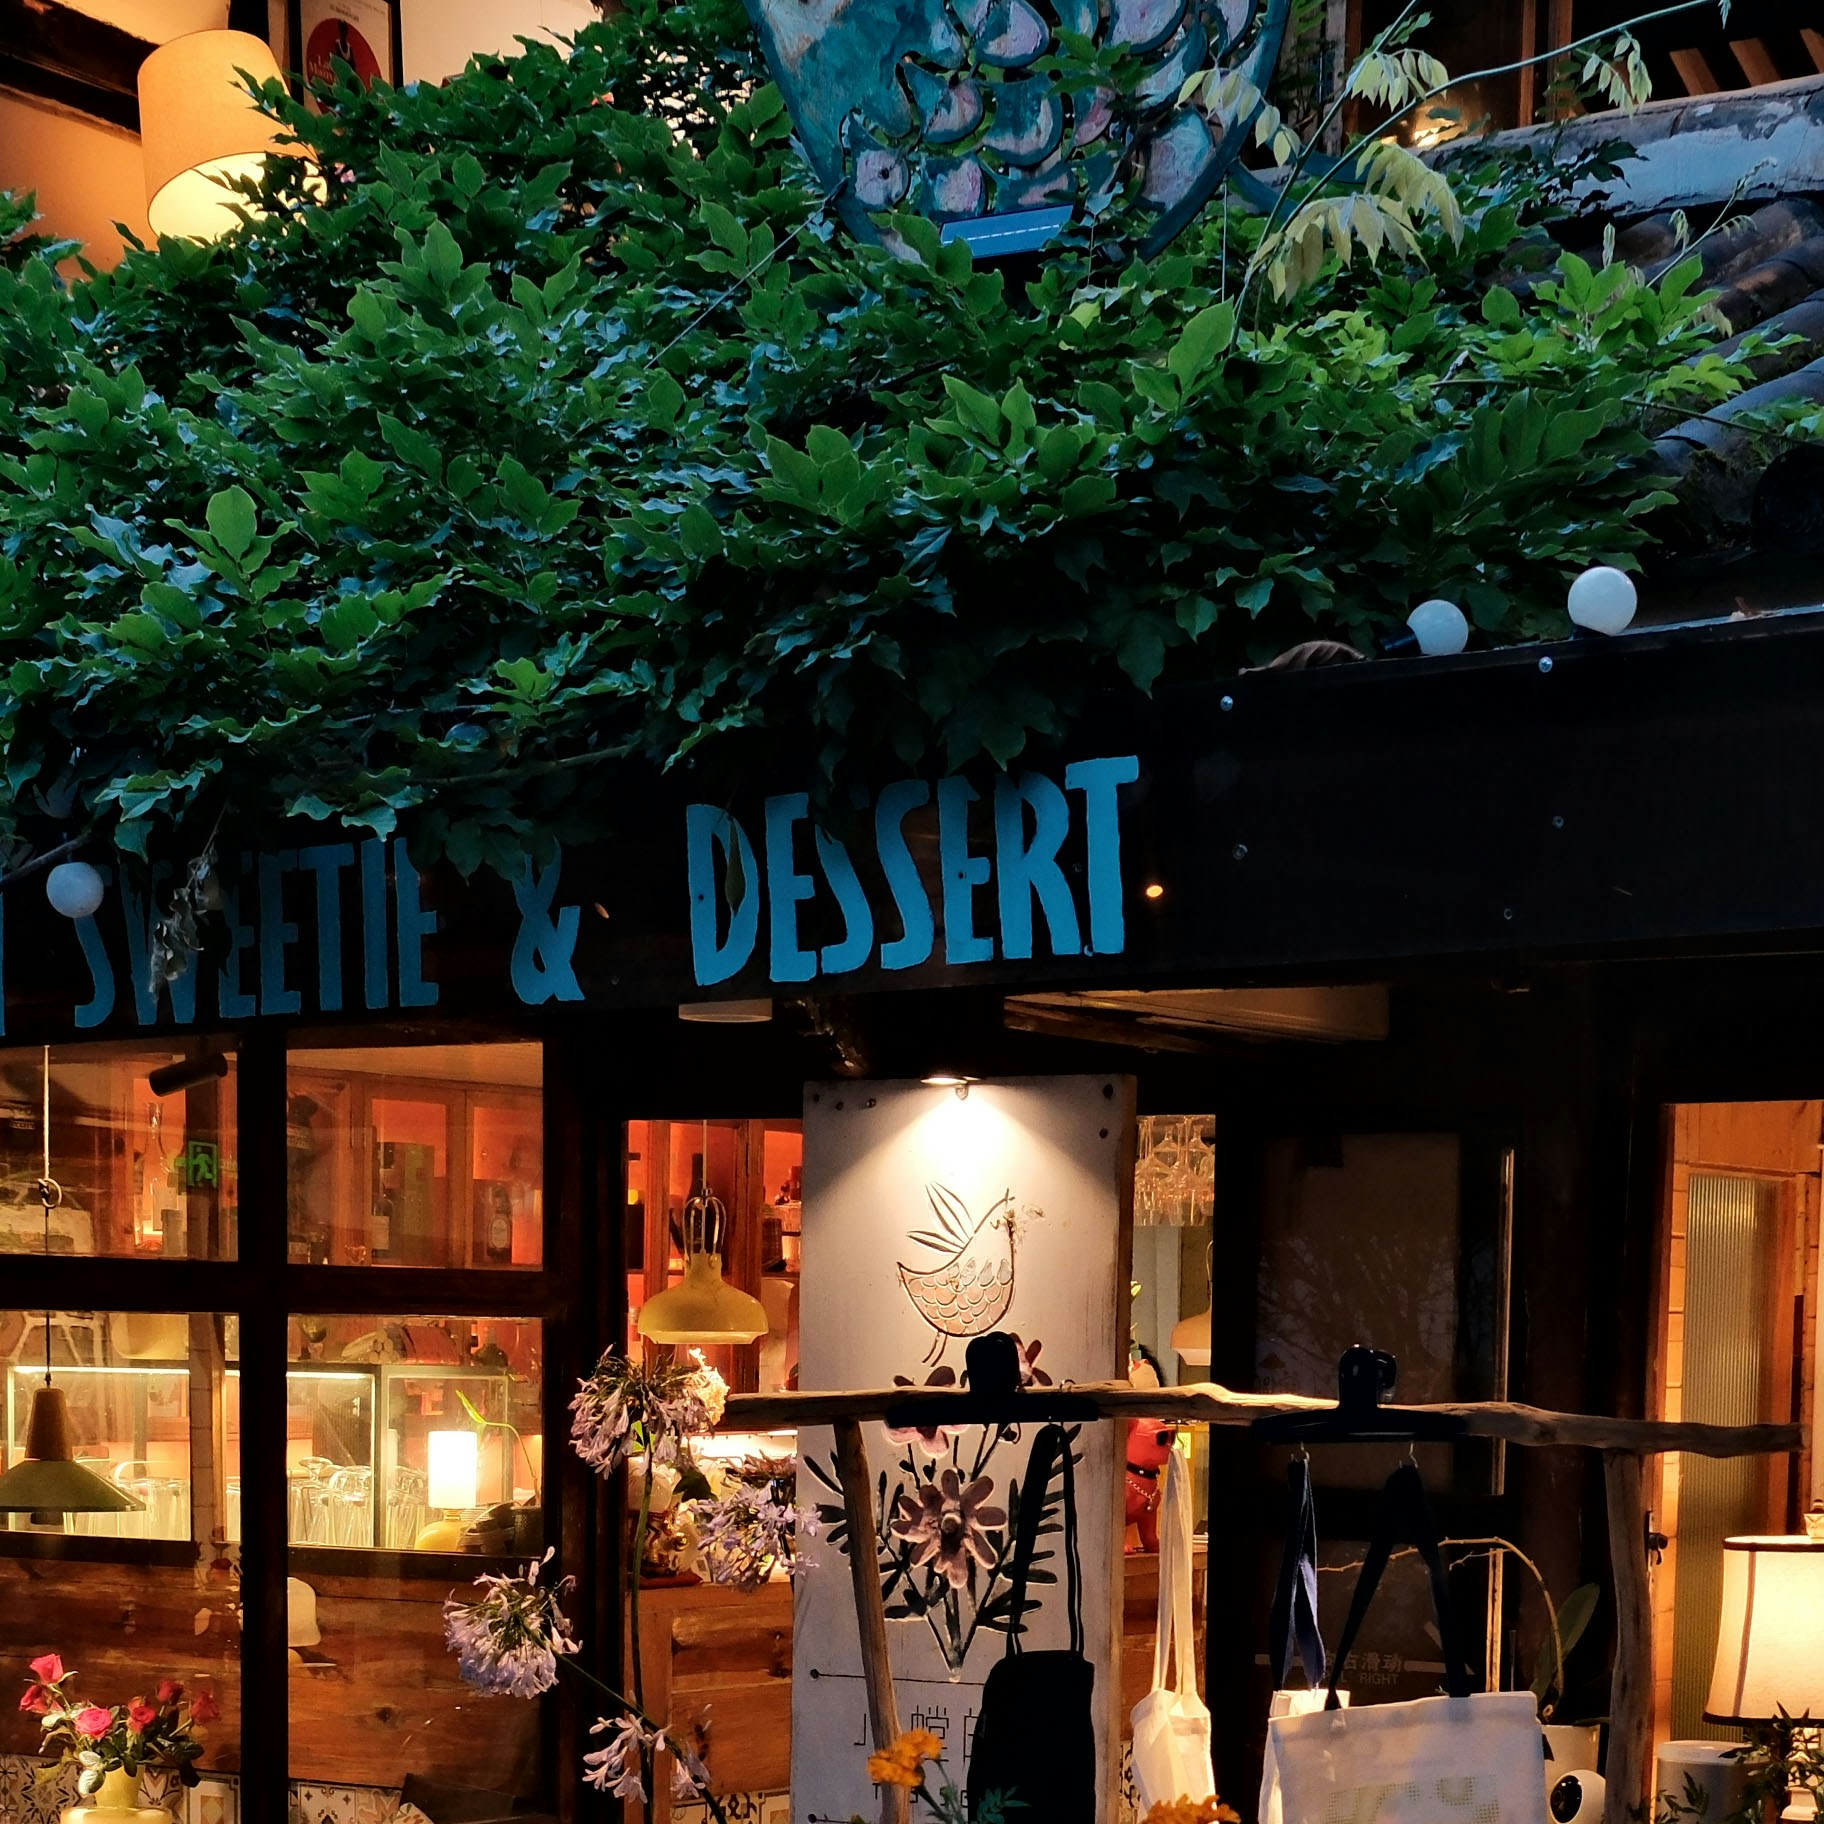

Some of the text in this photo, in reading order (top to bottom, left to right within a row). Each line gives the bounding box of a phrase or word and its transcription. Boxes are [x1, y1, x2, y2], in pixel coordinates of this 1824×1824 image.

[509, 835, 587, 1006] &
[686, 755, 1139, 987] DESSERT
[1359, 1672, 1400, 1685] RIGHT
